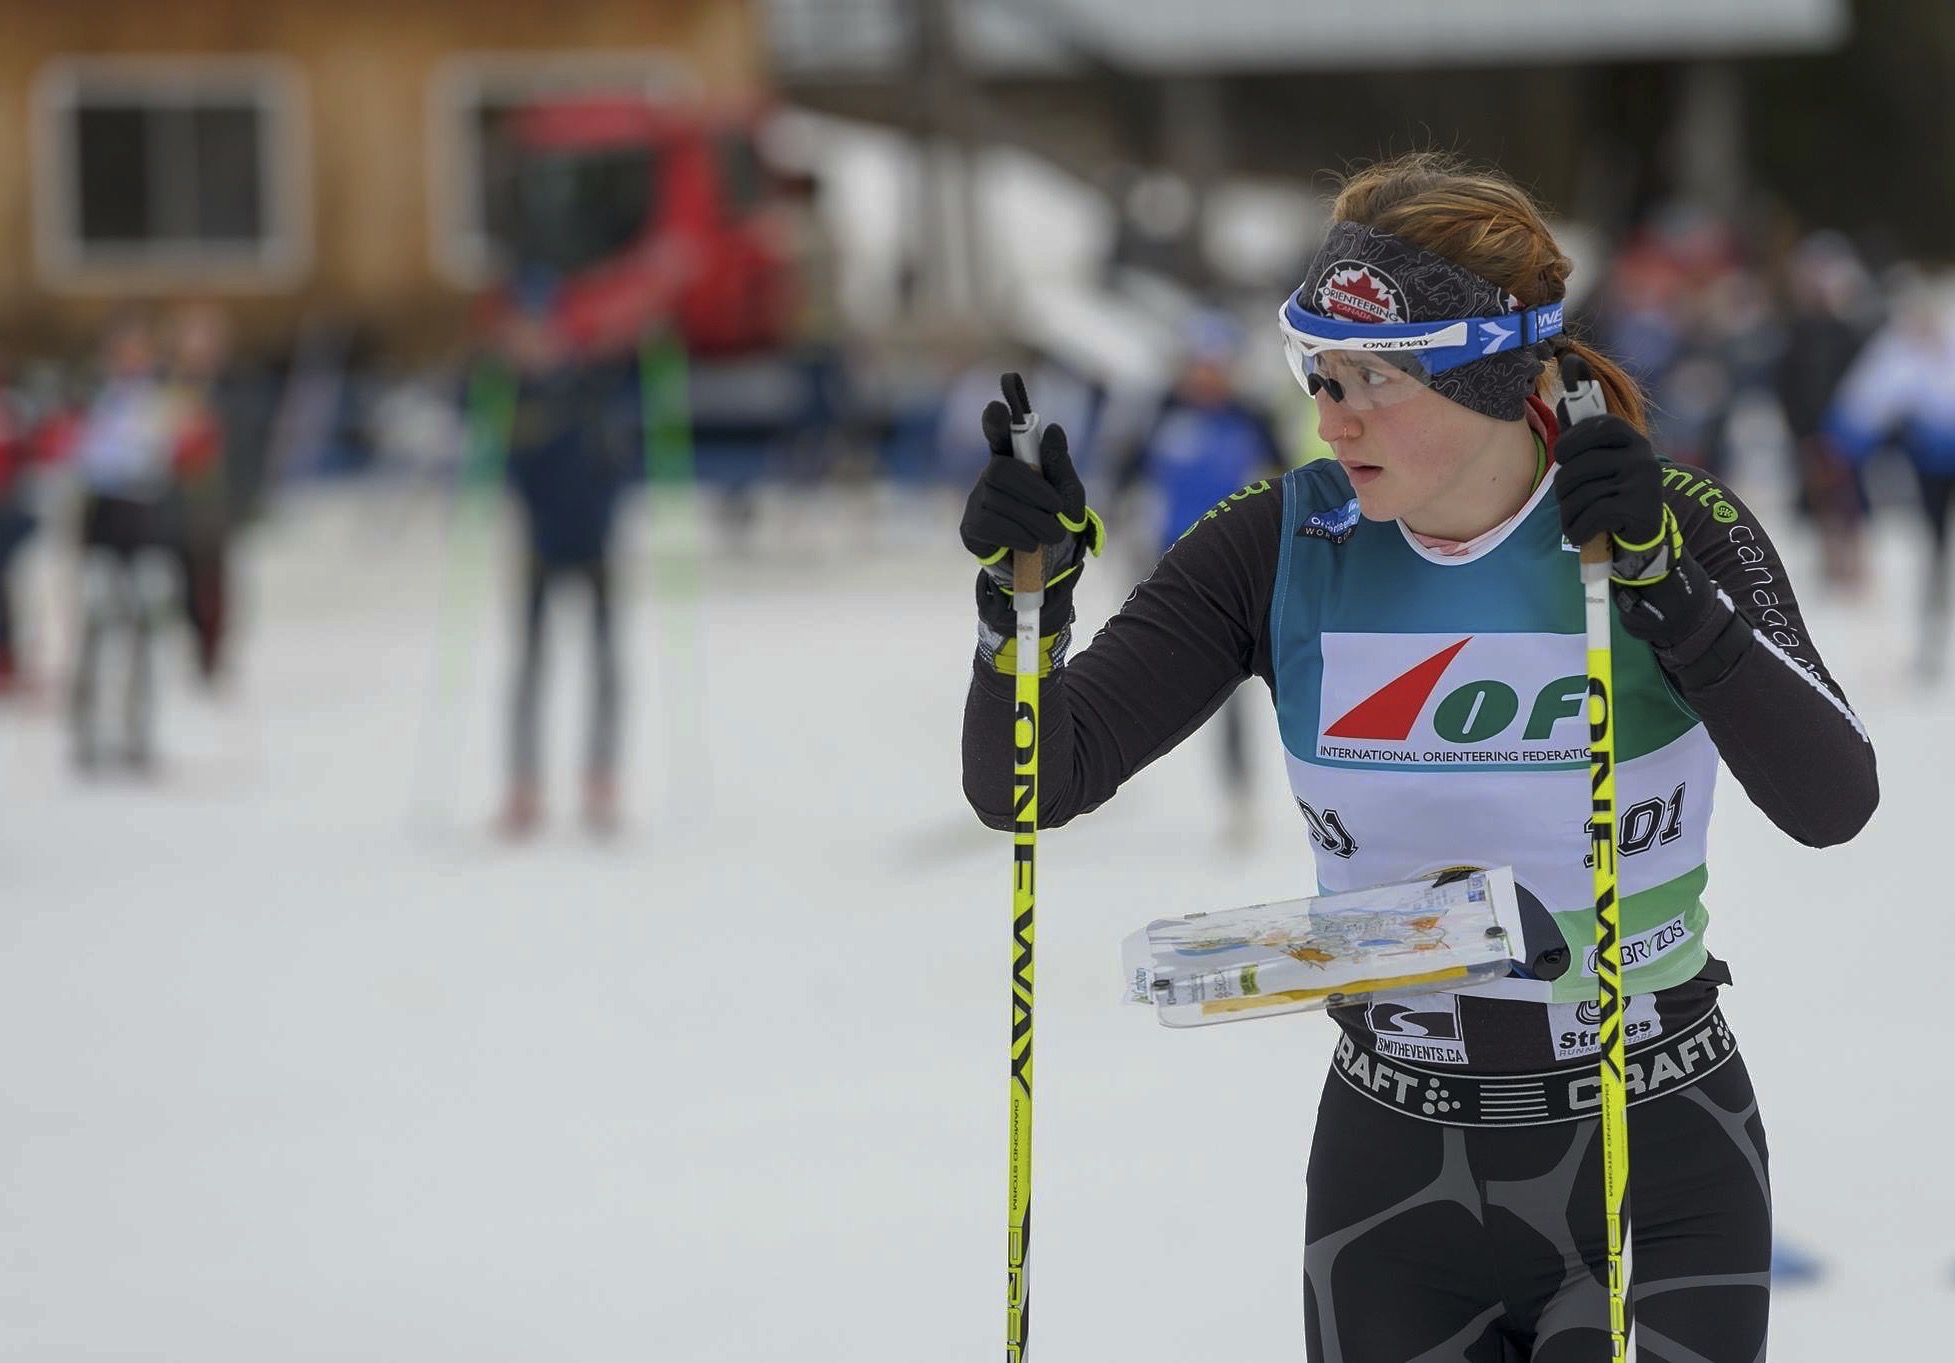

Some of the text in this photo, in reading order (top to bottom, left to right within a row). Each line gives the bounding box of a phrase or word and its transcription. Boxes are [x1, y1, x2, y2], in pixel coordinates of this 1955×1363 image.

[1322, 287, 1398, 321] ORIENTEERING
[1336, 303, 1372, 320] CANADA
[1320, 745, 1592, 762] INTERNATIONAL ORIENTEERING FEDERATIO
[1559, 1020, 1651, 1049] Stres
[1378, 1038, 1464, 1063] SMITHEVENTS.CA
[1335, 1033, 1419, 1104] RAFT
